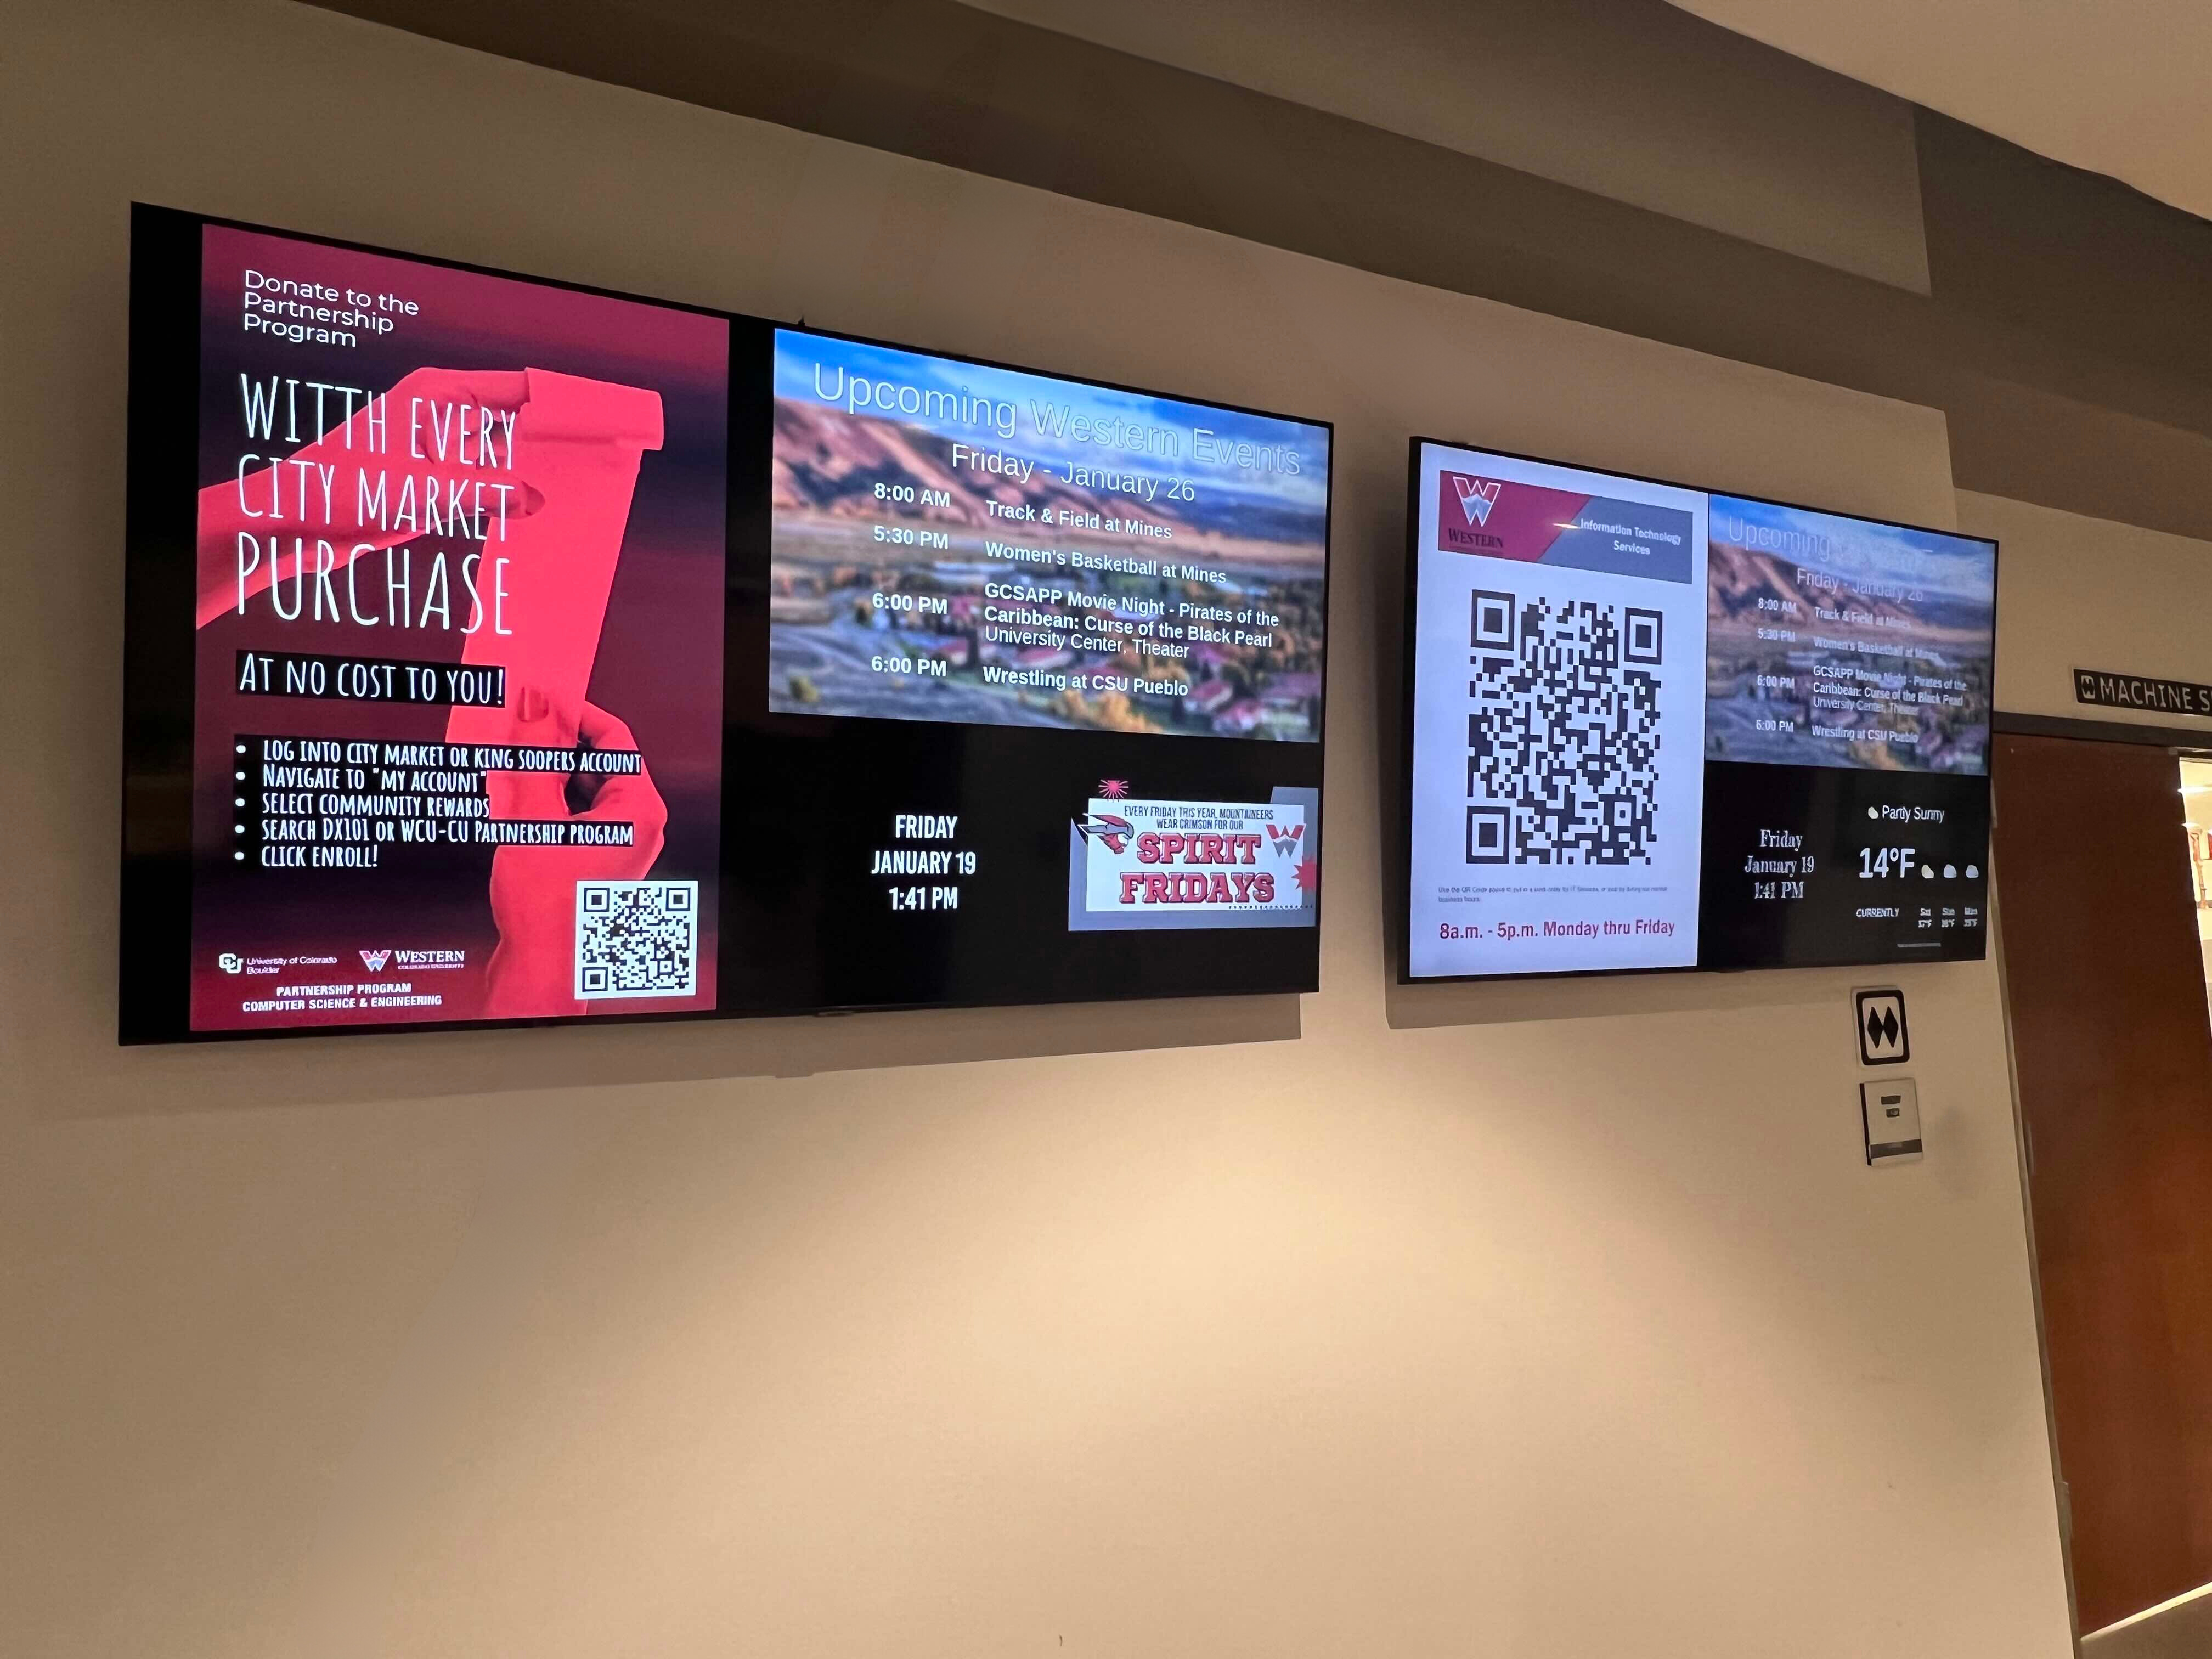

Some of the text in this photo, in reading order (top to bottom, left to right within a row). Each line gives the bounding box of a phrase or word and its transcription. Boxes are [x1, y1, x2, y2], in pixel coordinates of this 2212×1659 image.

[244, 270, 419, 315] Donate to the
[244, 291, 394, 334] Partnership
[244, 314, 356, 348] Program
[240, 373, 516, 470] WITTH EVERY
[814, 363, 1301, 475] Upcoming Western Events
[952, 443, 1194, 503] Friday January 26
[238, 454, 515, 542] CITY MARKET
[874, 482, 950, 508] 8:00 AM
[986, 500, 1172, 539] Track & Field at Mines
[1580, 518, 1681, 545] Information Technology
[874, 526, 948, 550] 5:30 PM
[1449, 528, 1503, 548] WESTERN
[1614, 540, 1650, 555] Services
[1729, 516, 1830, 561] Upcoming
[985, 541, 1226, 584] Women's Basketball at Mines
[238, 532, 512, 635] PURCHASE
[1797, 568, 1840, 595] Friday
[1852, 580, 1905, 603] January
[872, 592, 947, 615] 6:00 PM
[984, 583, 1278, 627] GCSAPP Movie Night Pirates of the
[1758, 597, 1778, 611] 8:00
[1815, 607, 1840, 620] Track
[984, 607, 1272, 647] Caribbean: Curse of the Black Pearl
[1781, 629, 1795, 642] PM
[985, 625, 1065, 651] University
[1132, 639, 1189, 659] Theater
[871, 656, 947, 677] 6:00 PM
[1814, 665, 1942, 689] GCSAPP Movie Pirates
[286, 661, 325, 695] NO
[338, 663, 396, 699] COST
[405, 667, 437, 701] TO
[447, 669, 504, 705] YOU!
[984, 667, 1188, 697] Wrestling at CSU Pueblo
[1757, 675, 1795, 689] 6:00 PM
[2100, 677, 2212, 711] MACHINE S
[1813, 696, 1855, 710] University
[1865, 687, 1963, 707] Curse the Black Pearl
[1756, 720, 1793, 733] 6:00 PM
[1812, 725, 1887, 741] Wrestling CSU
[263, 740, 641, 774] LOG INTO CITY MARKET OR KING SOOPERS ACCOUNT
[263, 765, 487, 793] NAVIGATE TO "MY ACCOUNT"
[262, 793, 489, 818] SELECT COMMUNITY REWARDS
[1125, 806, 1149, 817] EVERY
[1150, 806, 1176, 817] FRIDAY
[1180, 807, 1195, 818] THIS
[1220, 809, 1273, 819] MOUNTAINEERS
[1882, 805, 1944, 823] Partly Sunny
[262, 819, 316, 840] SEARCH
[376, 823, 395, 842] OR
[401, 820, 468, 843] WCU-CU
[475, 822, 565, 844] PARTNERSHIP
[570, 824, 633, 845] PROGRAM
[896, 814, 958, 839] FRIDAY
[1157, 819, 1243, 830] WEAR CRIMSON FOR OUR
[1137, 832, 1261, 864] SPIRIT
[1759, 829, 1803, 851] Friday
[261, 845, 378, 867] CLICK ENROLL!
[871, 850, 975, 874] JANUARY 19
[1745, 856, 1814, 877] January 19
[1859, 848, 1915, 878] 14°F
[889, 887, 958, 910] 1:41 PM
[1119, 872, 1274, 904] FRIDAYS
[1754, 881, 1804, 899] 1:41 PM
[1857, 908, 1899, 917] CURRENTLY
[1440, 919, 1674, 941] 8a.m. 5p.m. Monday thru Friday
[395, 950, 465, 963] WESTERN
[276, 983, 411, 996] PARTNERSHIP PROGRAM
[242, 996, 442, 1012] COMPUTER SCIENCE & ENGINEERING
